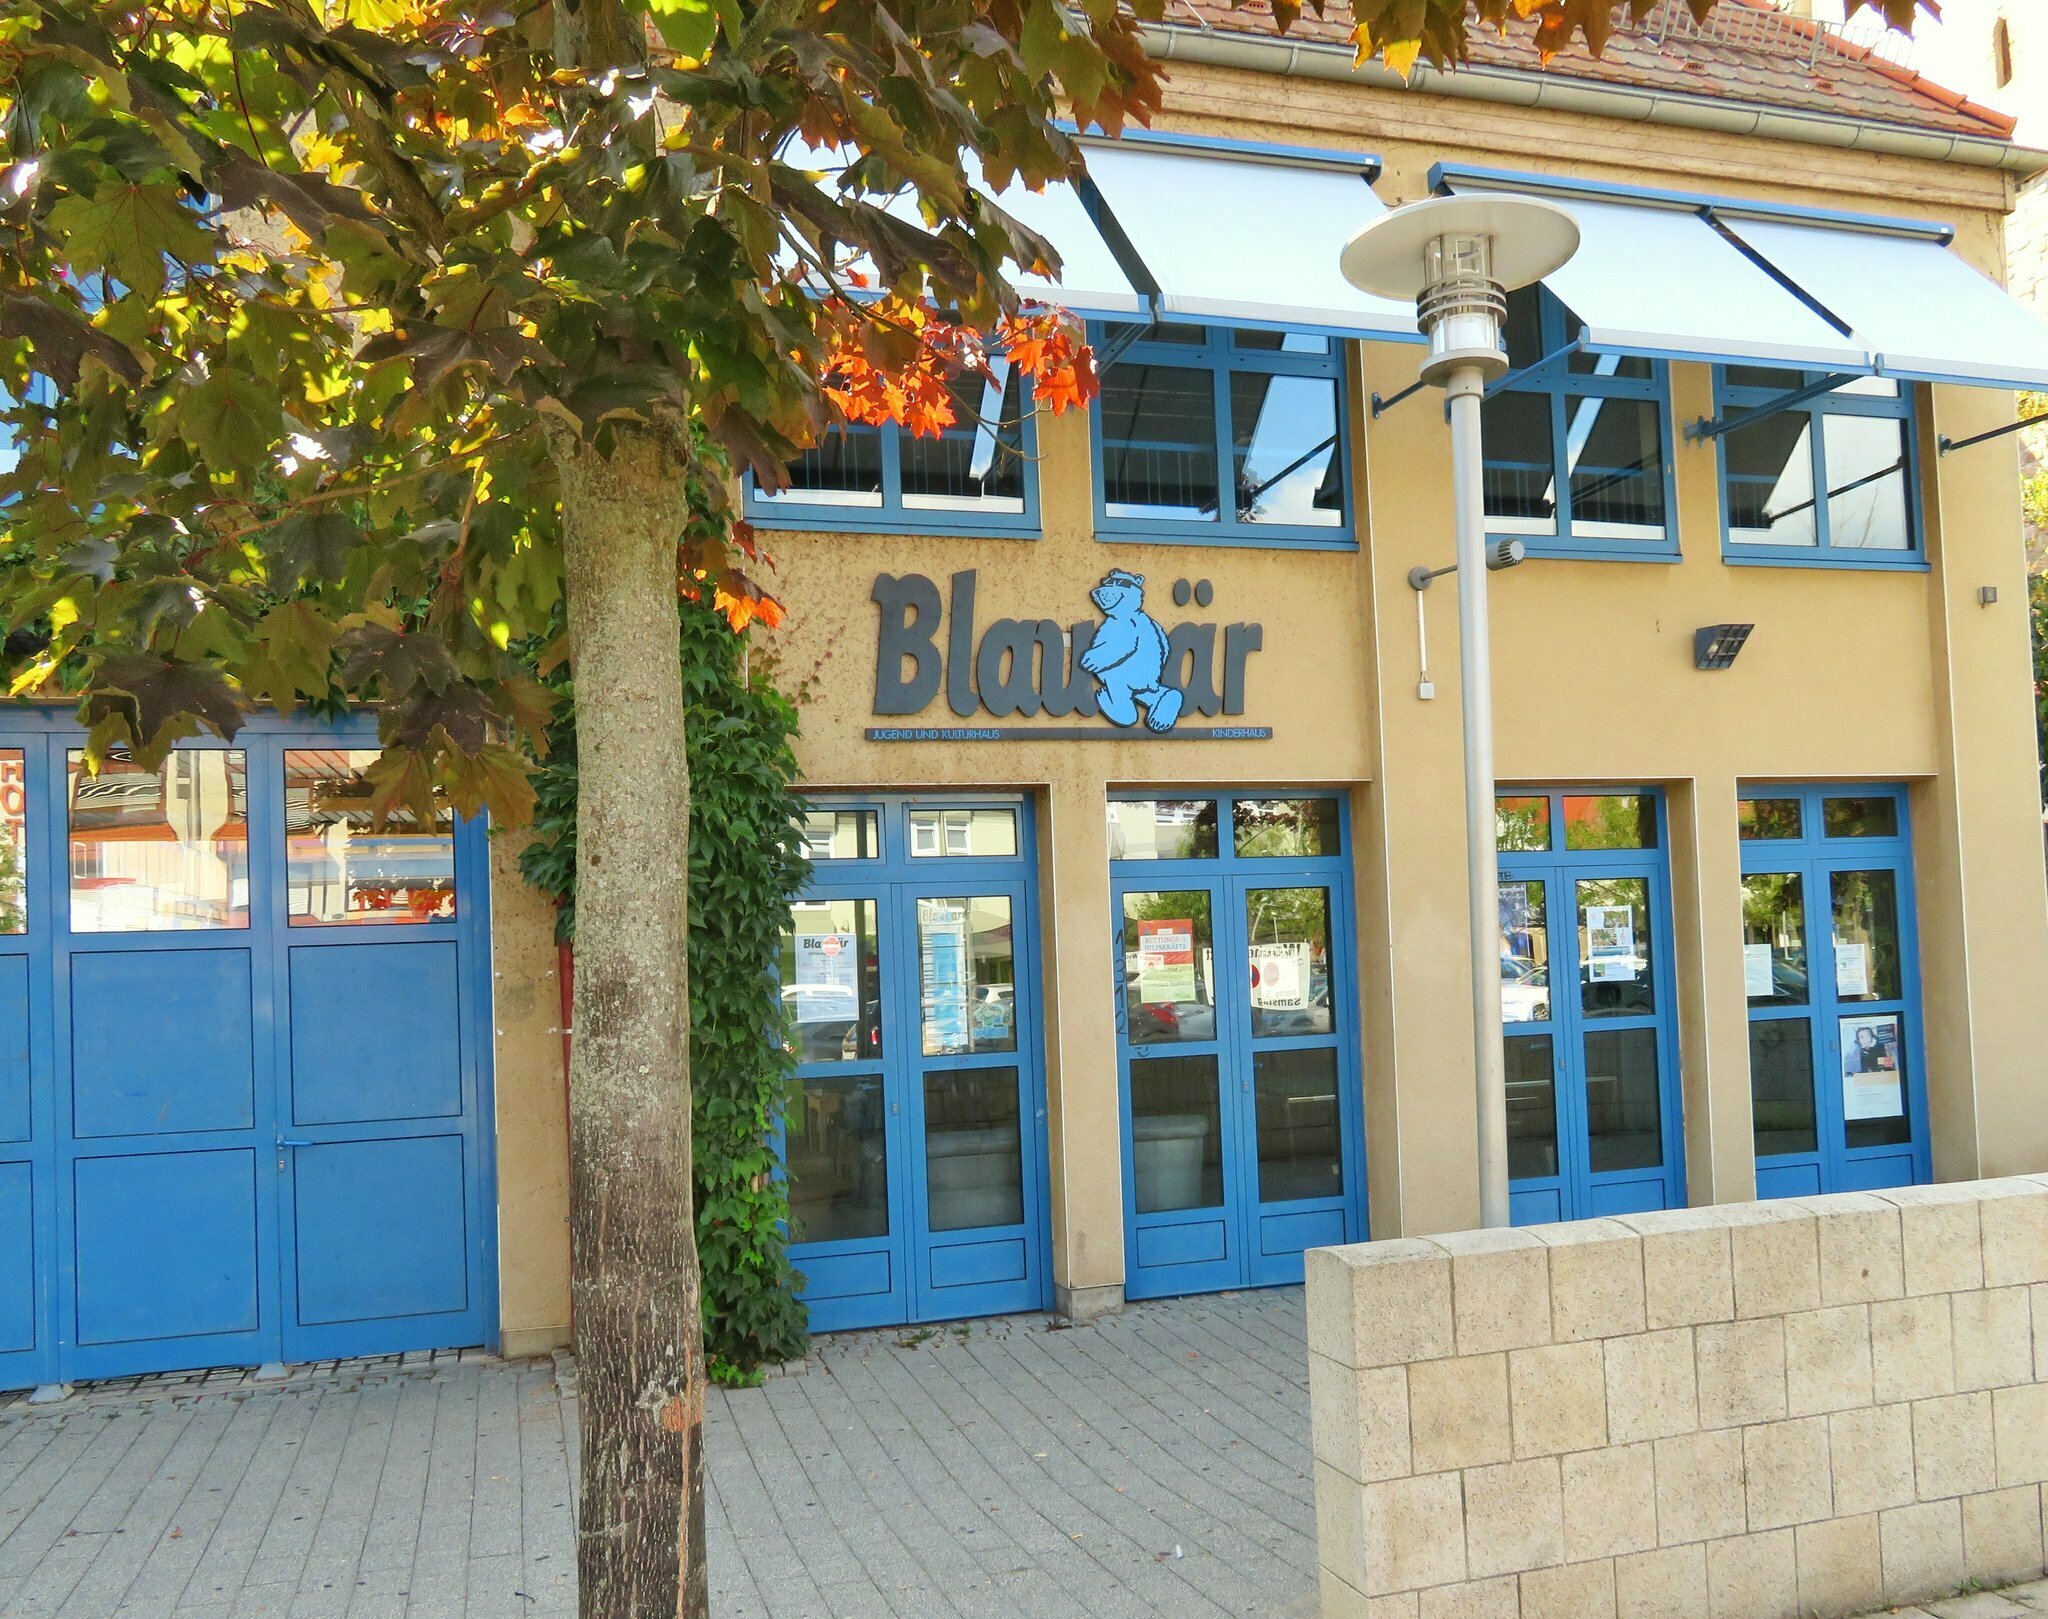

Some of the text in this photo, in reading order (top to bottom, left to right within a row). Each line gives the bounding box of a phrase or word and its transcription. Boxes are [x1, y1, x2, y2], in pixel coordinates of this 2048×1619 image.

[871, 568, 1263, 718] Blauär
[873, 729, 1000, 740] JUGEND UND KULTURHAUS
[1212, 728, 1267, 738] KINDERHAUS
